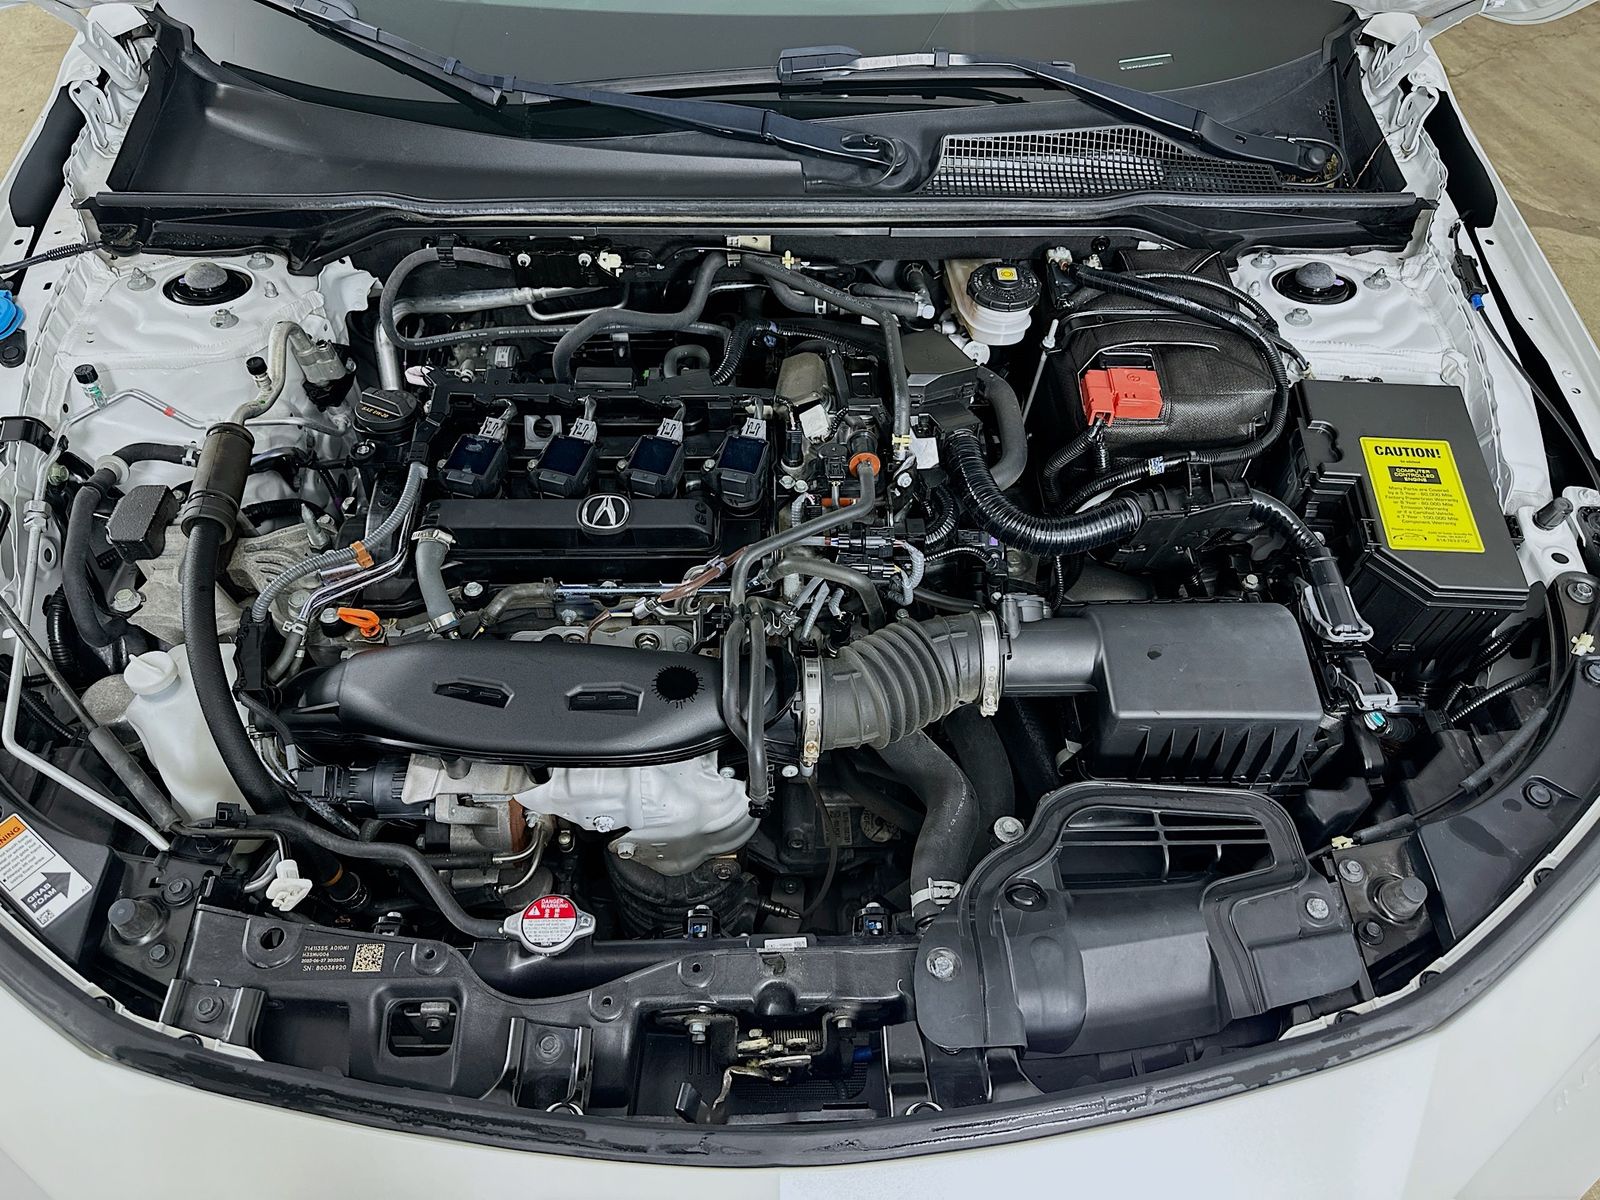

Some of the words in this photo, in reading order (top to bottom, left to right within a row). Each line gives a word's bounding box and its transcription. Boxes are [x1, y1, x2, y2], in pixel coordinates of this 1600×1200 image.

[1374, 446, 1441, 458] CAUTION!
[0, 826, 21, 846] NING
[27, 882, 52, 904] GRAB
[32, 887, 57, 909] FOAM
